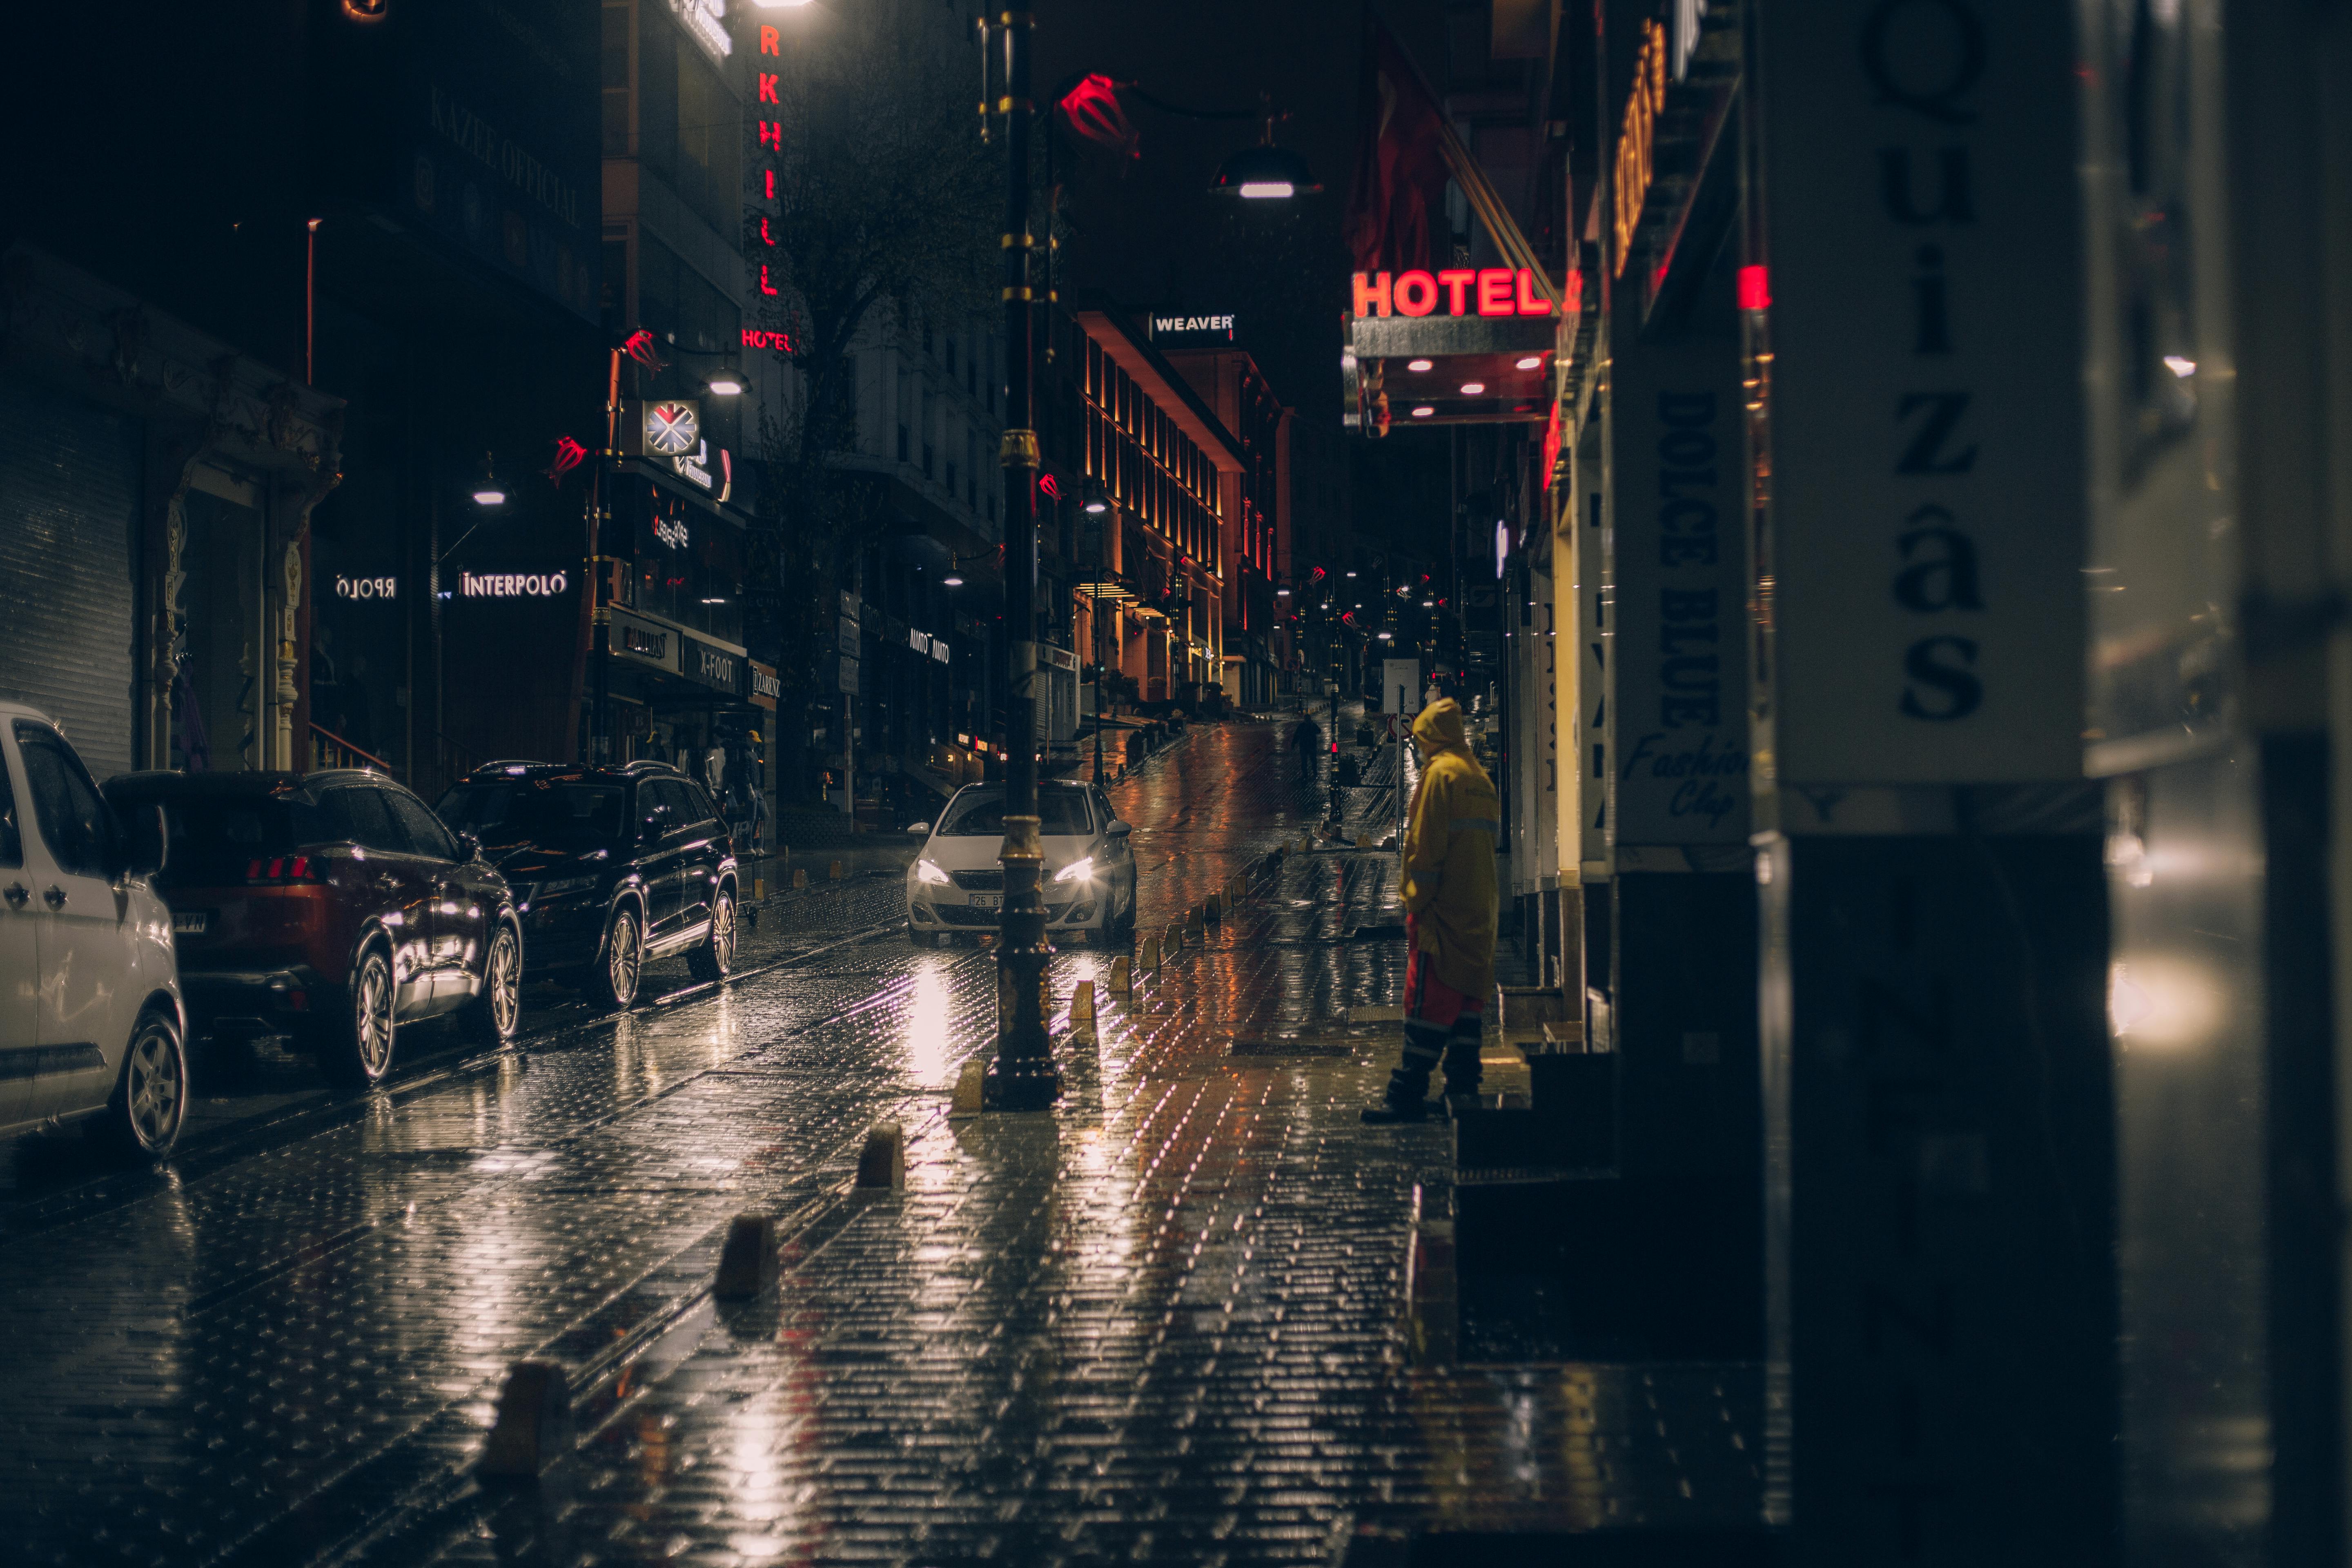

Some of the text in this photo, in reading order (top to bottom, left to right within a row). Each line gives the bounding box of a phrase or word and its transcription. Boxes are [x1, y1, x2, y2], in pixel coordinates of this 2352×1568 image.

[1352, 267, 1552, 317] HOTEL
[741, 328, 793, 352] HOTEL
[1155, 315, 1233, 331] WEAVER
[1657, 390, 1720, 728] DOLCE BLUE
[909, 627, 928, 655] AMATO
[932, 639, 949, 664] AMATO
[700, 649, 733, 683] X-FOOT
[975, 896, 986, 906] 26
